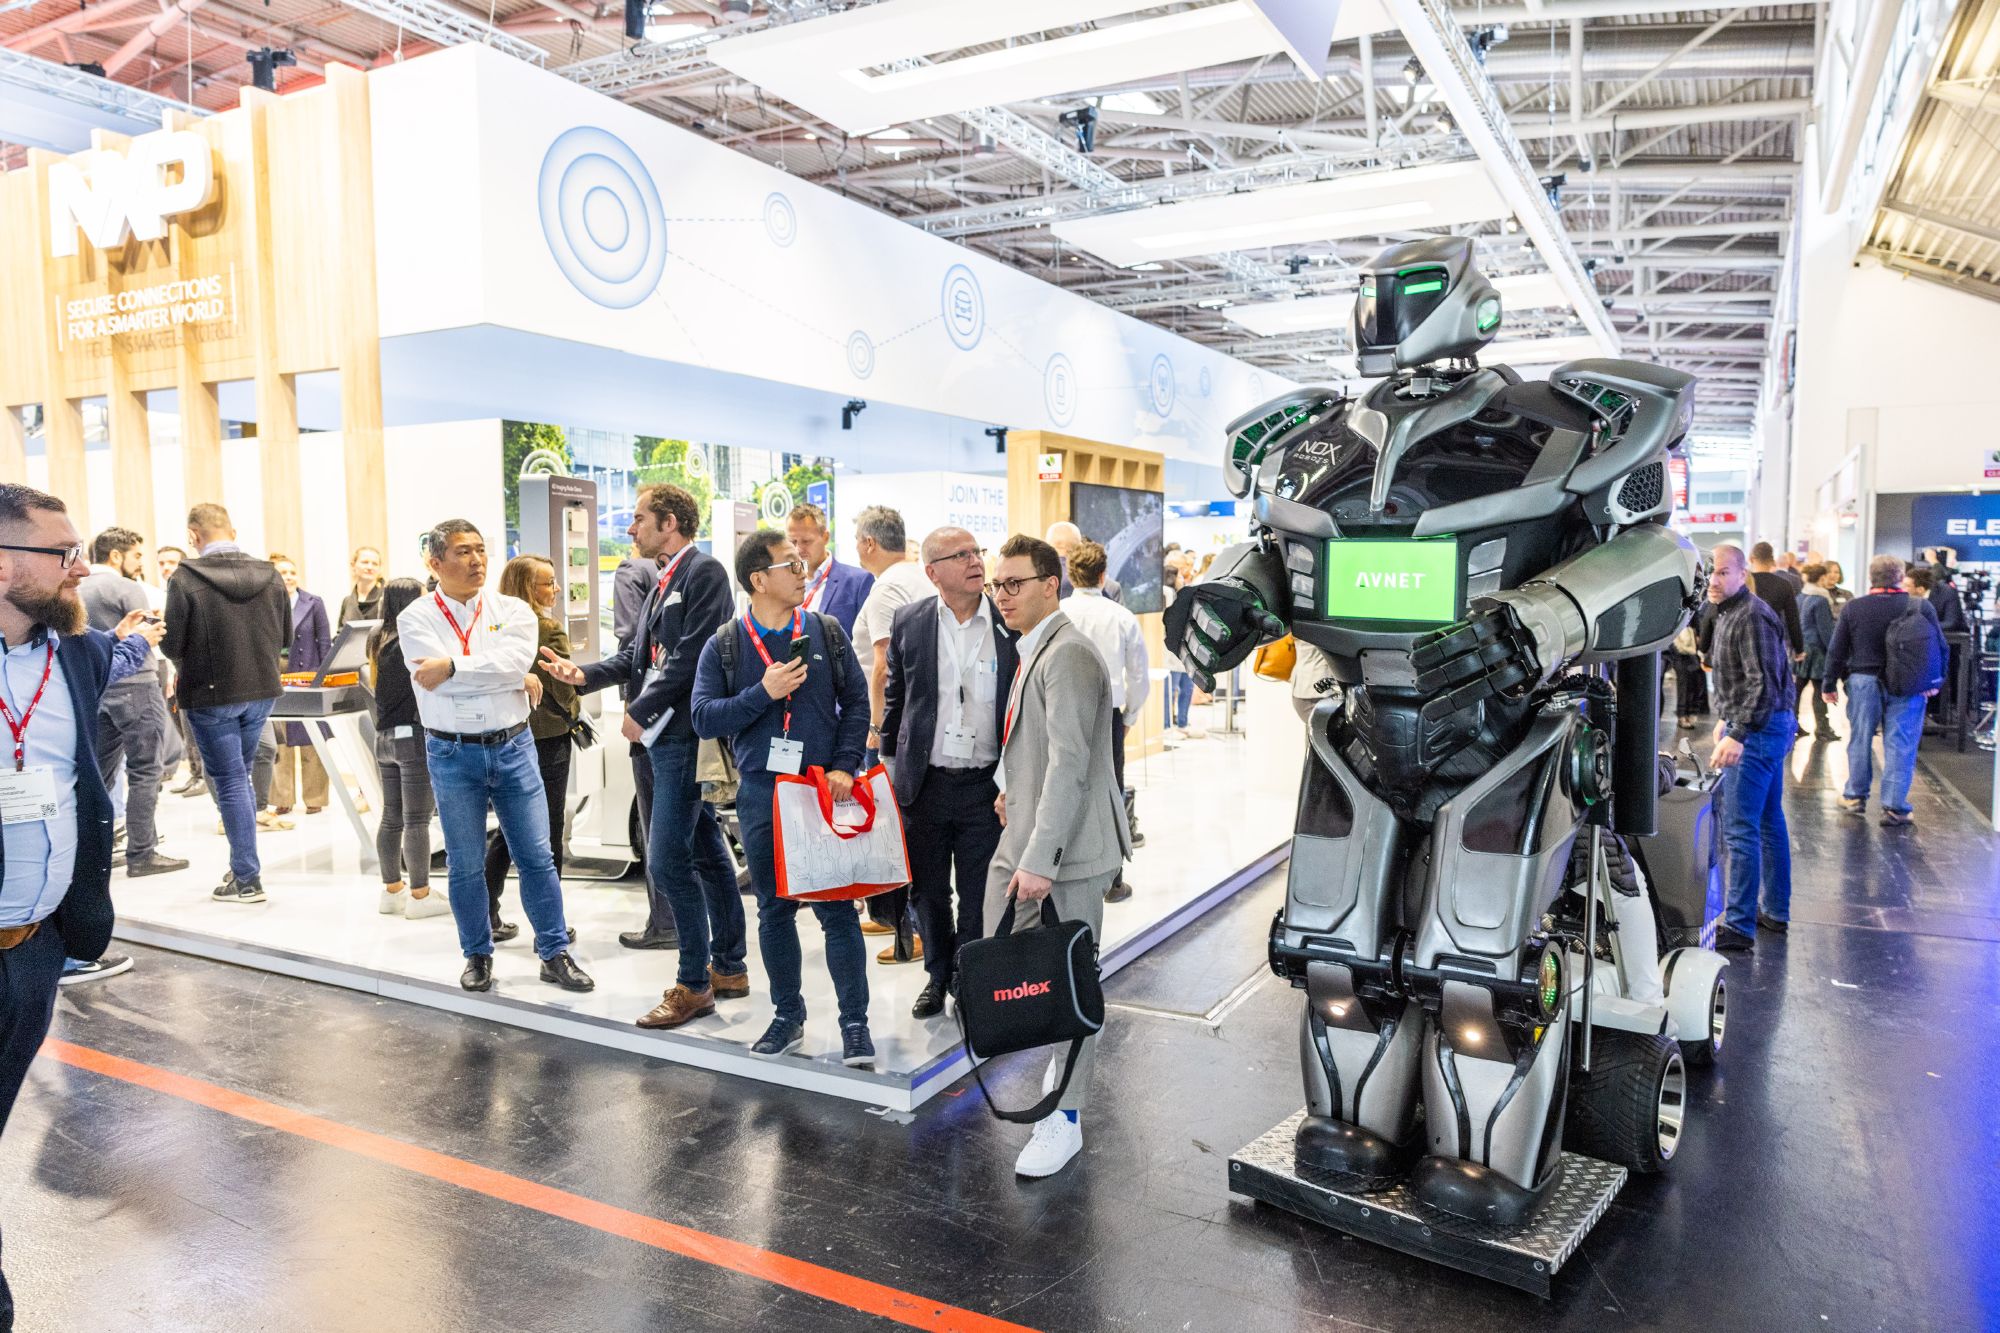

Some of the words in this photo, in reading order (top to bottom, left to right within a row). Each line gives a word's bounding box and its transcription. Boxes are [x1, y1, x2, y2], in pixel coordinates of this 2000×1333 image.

[66, 295, 115, 320] SECURE
[117, 275, 222, 311] CONNECTIONS
[68, 319, 96, 342] FOR
[96, 318, 108, 337] A
[107, 307, 170, 336] SMARTER
[170, 298, 225, 326] WORLD
[1298, 440, 1342, 465] NOX
[947, 485, 979, 504] JOIN
[982, 487, 1005, 506] THE
[949, 512, 1007, 533] EXPERIEN
[1356, 572, 1426, 588] AVNET
[4, 708, 14, 723] molex
[993, 980, 1052, 1002] molex
